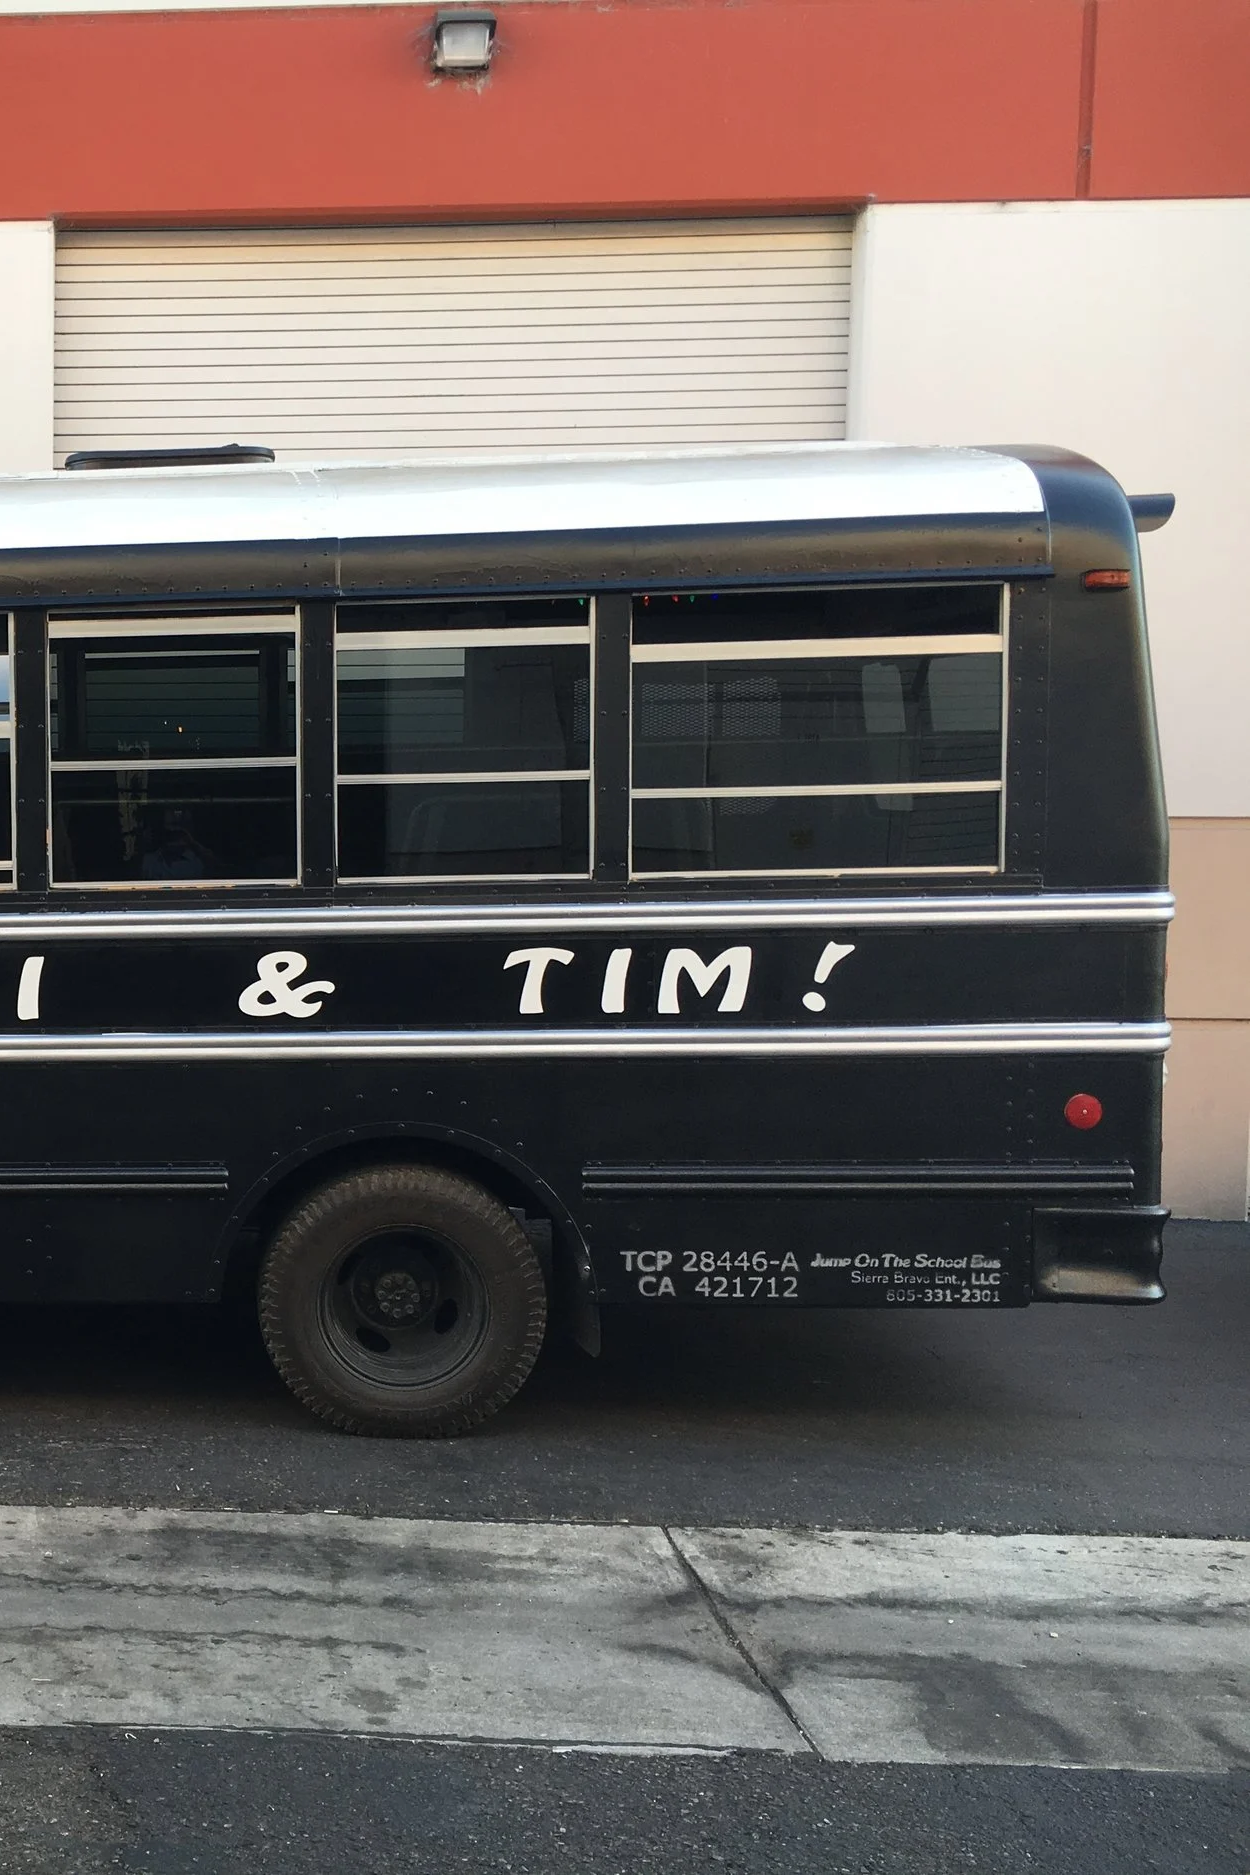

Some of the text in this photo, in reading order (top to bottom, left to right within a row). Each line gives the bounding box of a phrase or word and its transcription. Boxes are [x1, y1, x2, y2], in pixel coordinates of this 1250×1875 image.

[238, 950, 335, 1018] &
[619, 1250, 800, 1272] TCP 28446-A
[810, 1253, 1002, 1269] Jump On The School Bus
[638, 1275, 799, 1298] CA 421712
[851, 1270, 889, 1284] Sierra
[970, 1272, 1001, 1285] LLC
[886, 1289, 1001, 1303] 805-331-2301
